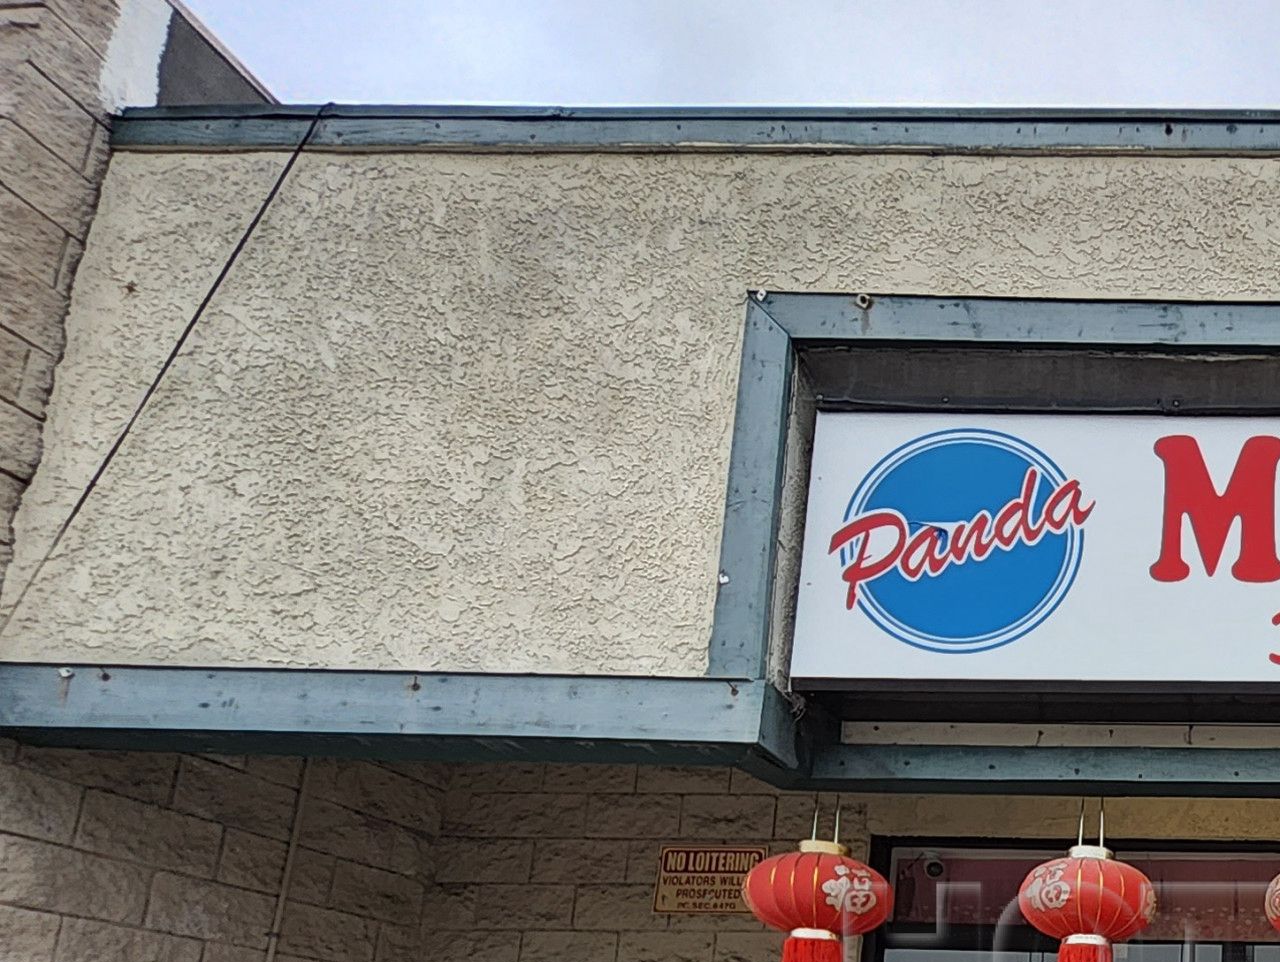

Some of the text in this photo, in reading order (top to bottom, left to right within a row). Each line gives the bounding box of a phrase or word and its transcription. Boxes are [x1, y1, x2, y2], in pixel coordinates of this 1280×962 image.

[828, 467, 1096, 610] Panda
[666, 851, 760, 872] NO LOITERING
[663, 875, 716, 886] VIOLATORS
